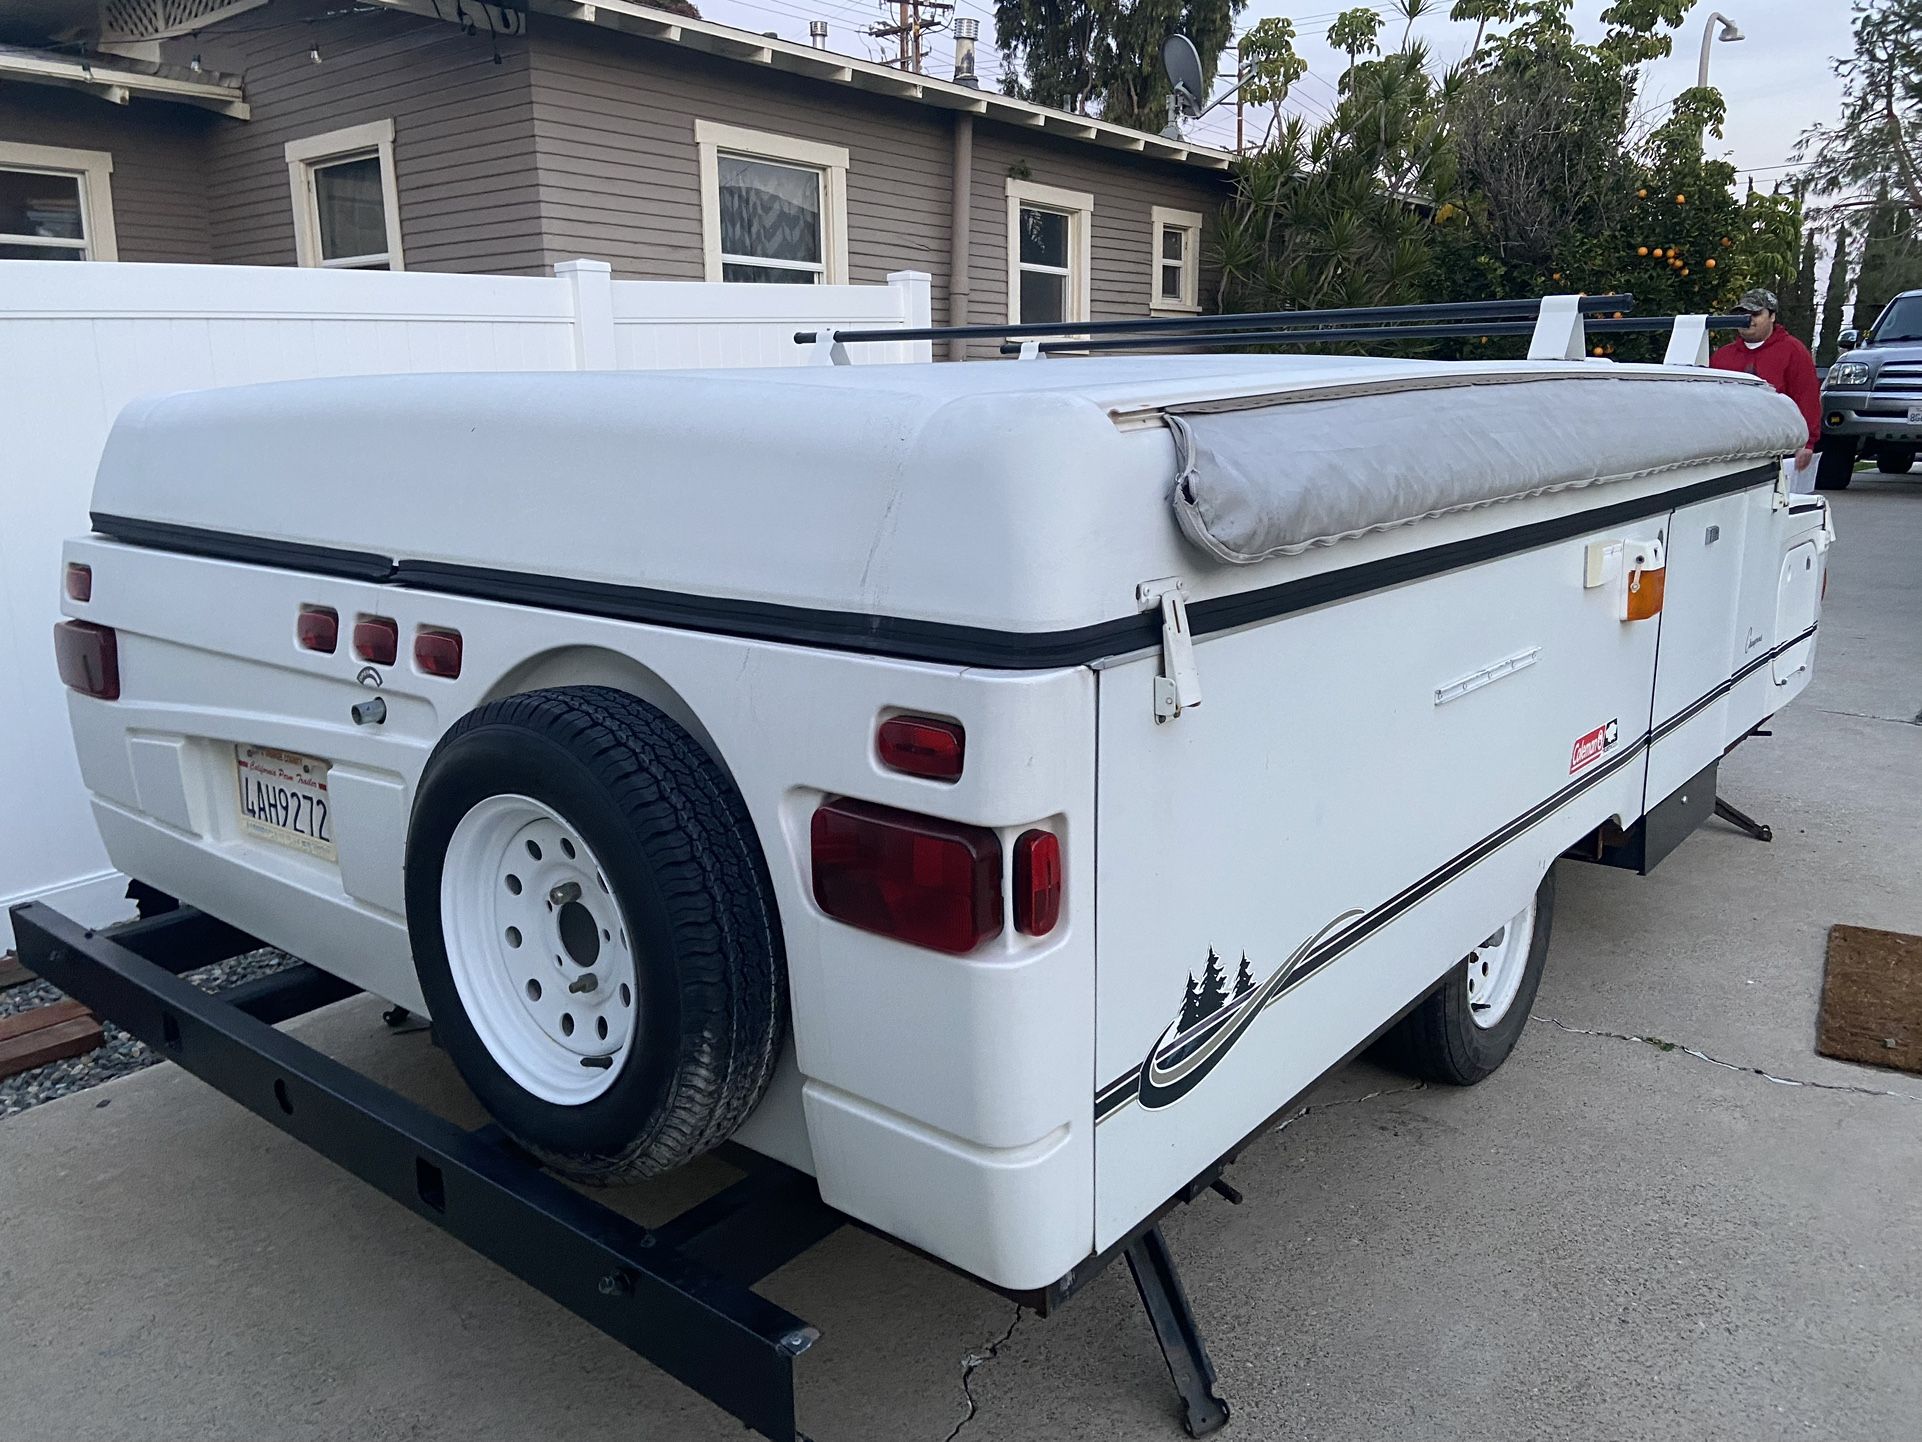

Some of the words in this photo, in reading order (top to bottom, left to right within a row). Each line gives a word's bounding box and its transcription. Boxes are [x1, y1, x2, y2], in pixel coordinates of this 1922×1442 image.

[249, 760, 276, 777] California
[296, 773, 317, 788] Trailer
[245, 777, 330, 842] 4AH9272
